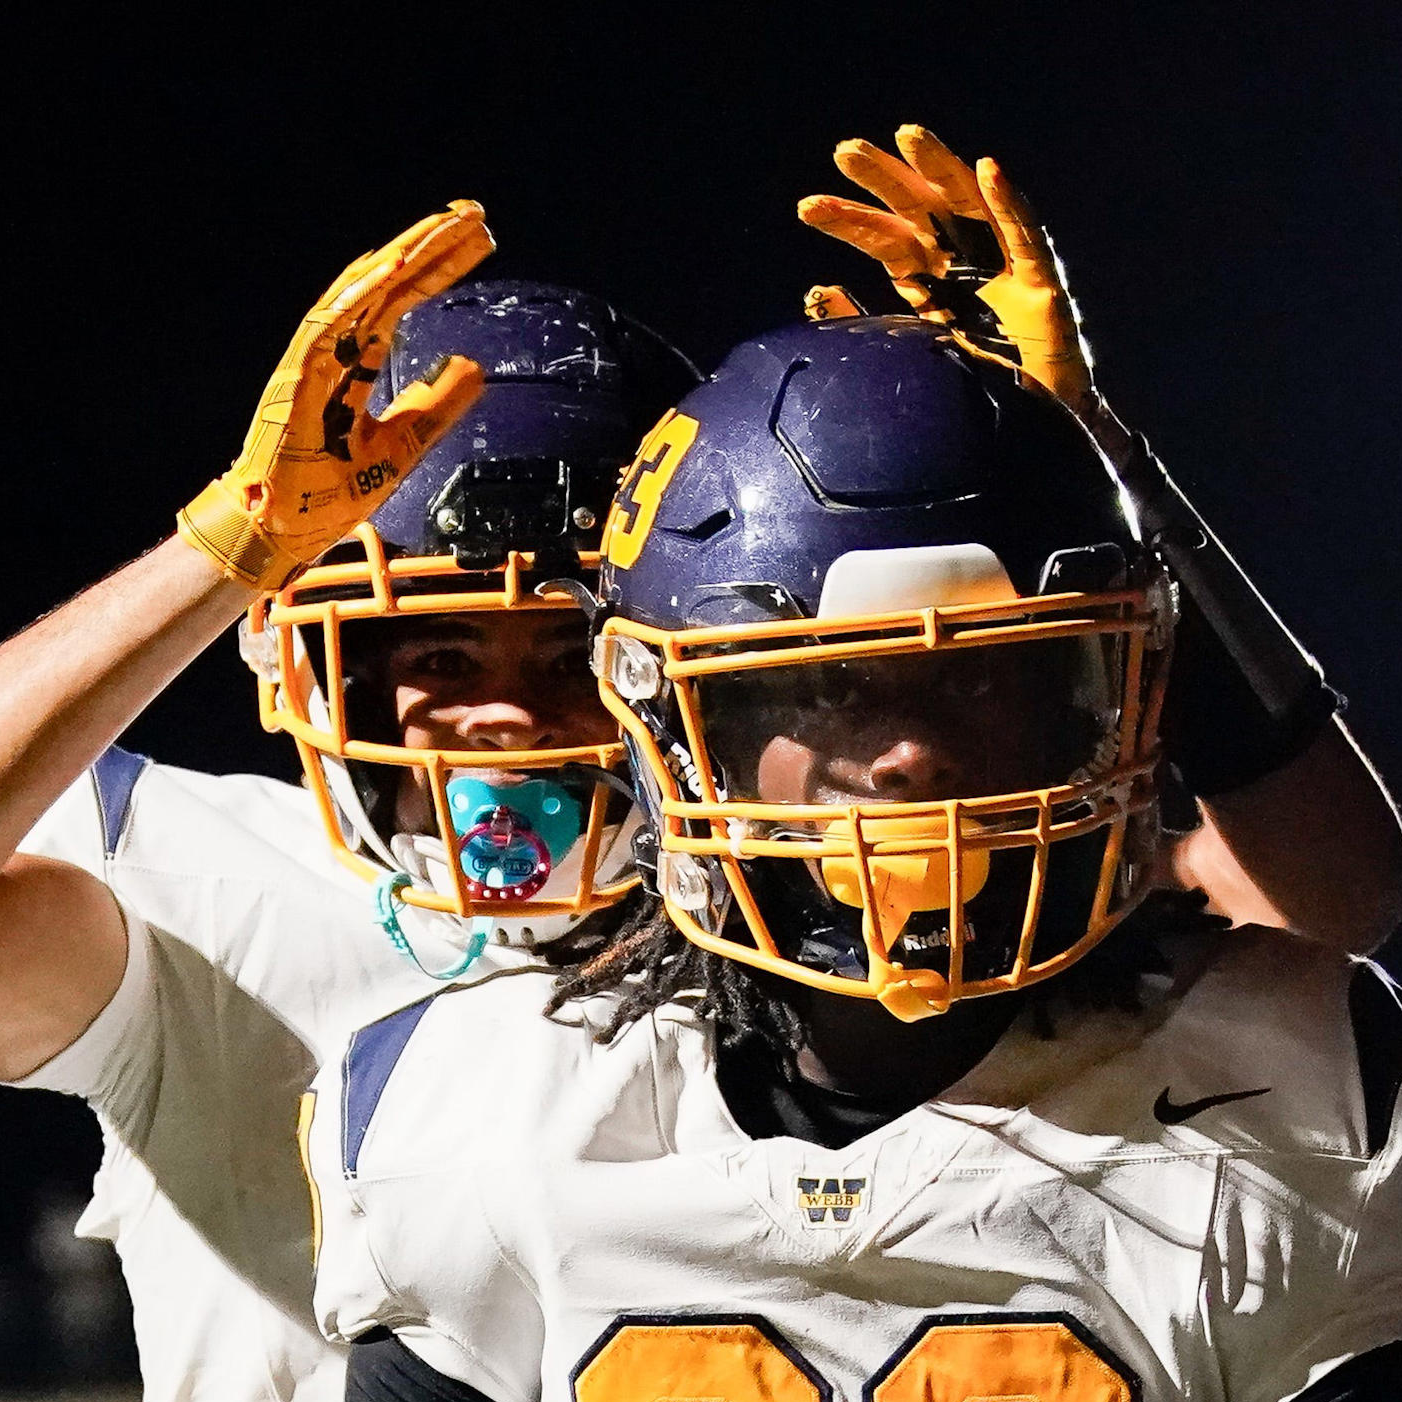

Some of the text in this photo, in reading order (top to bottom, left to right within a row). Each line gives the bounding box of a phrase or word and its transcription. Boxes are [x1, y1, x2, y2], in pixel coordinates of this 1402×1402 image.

[356, 456, 399, 495] 99%
[903, 922, 976, 951] Riddll
[806, 1195, 854, 1206] WEBB
